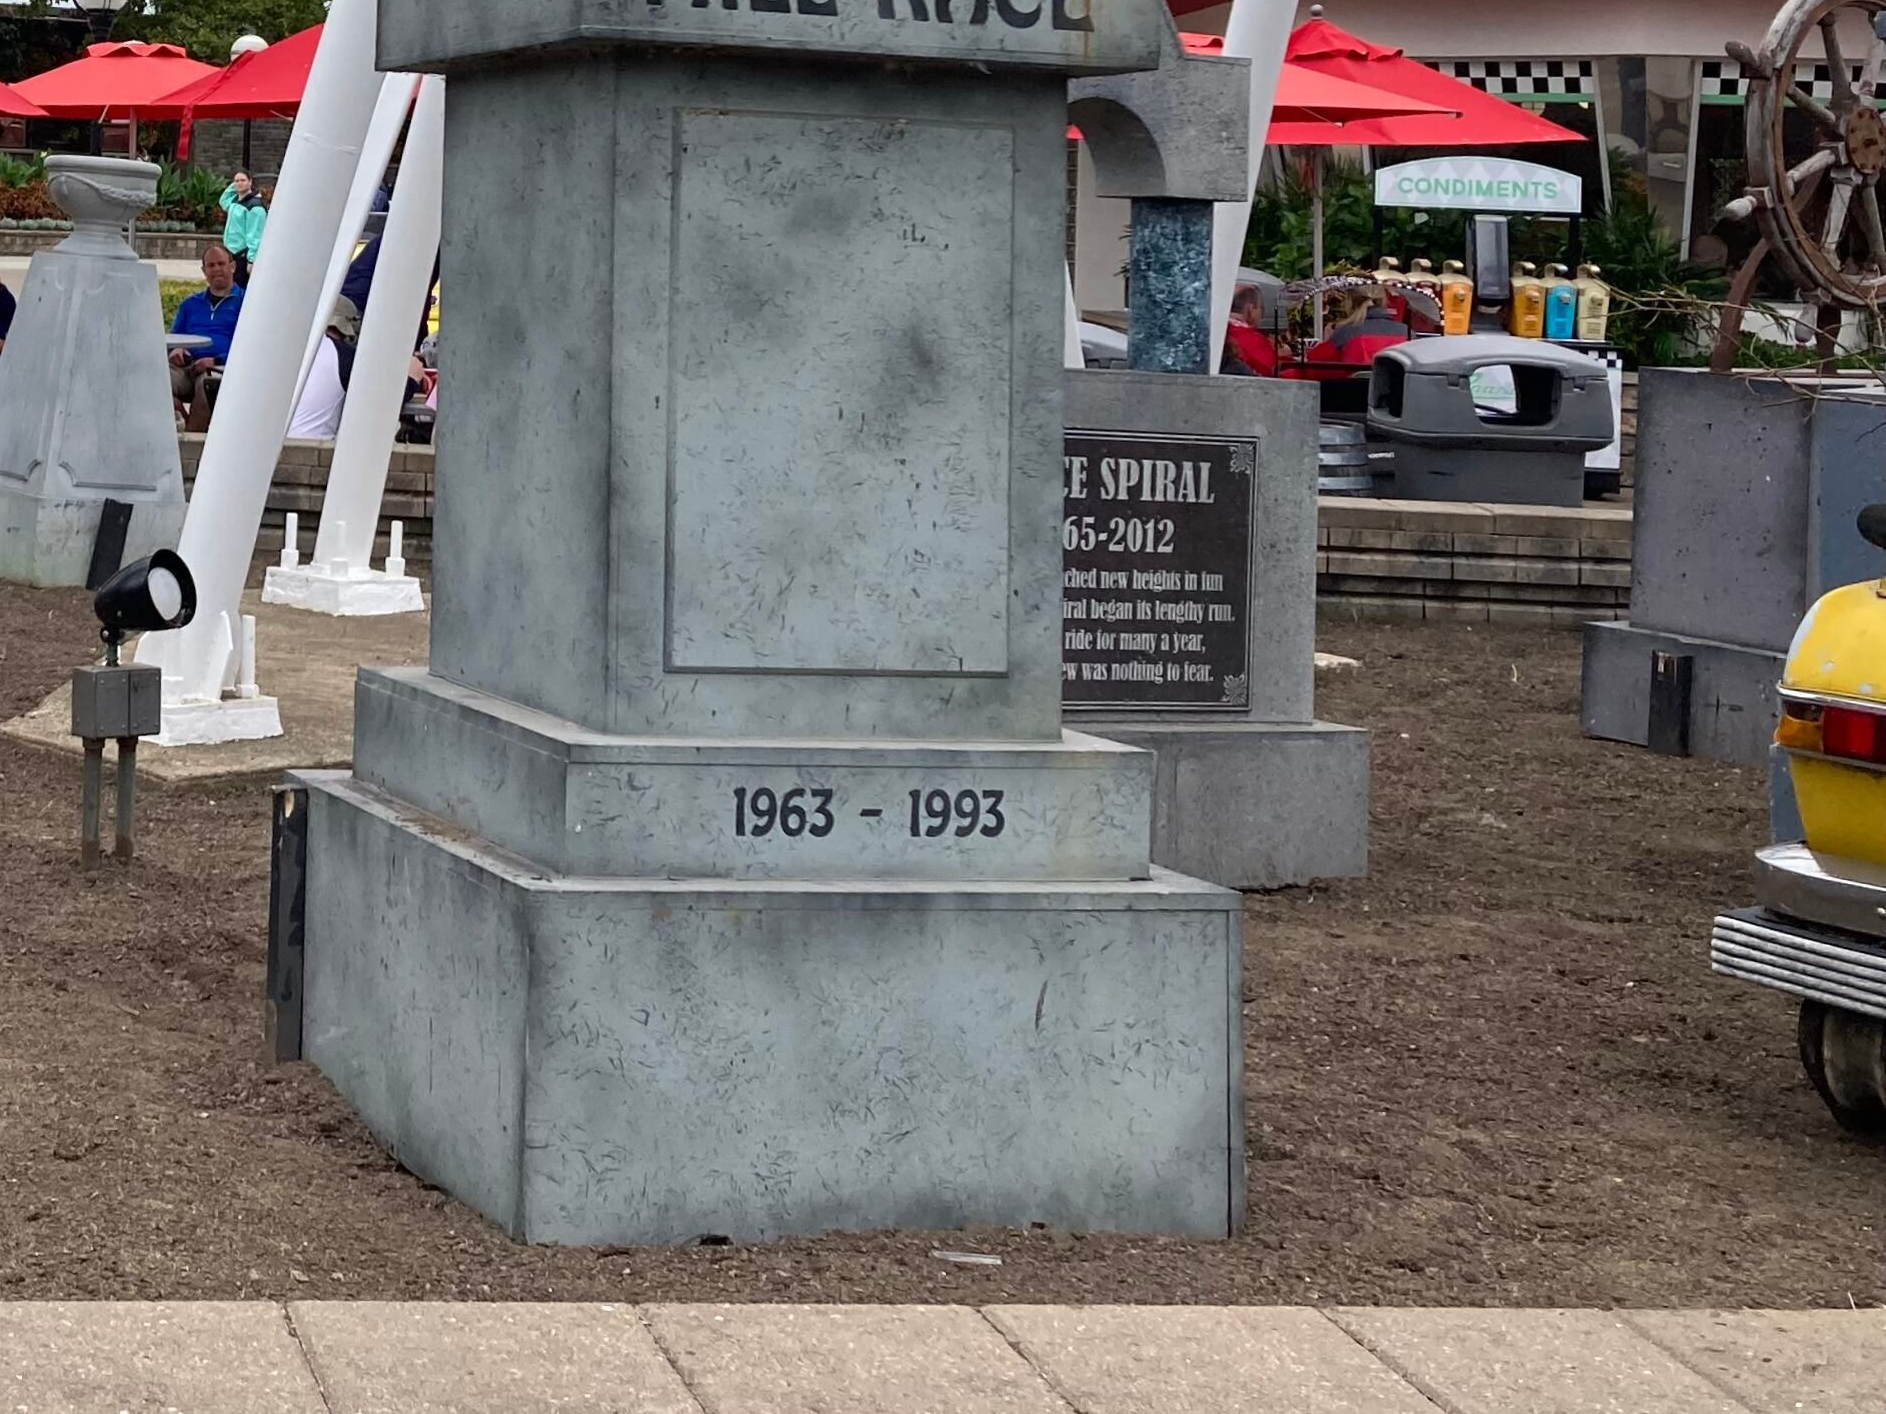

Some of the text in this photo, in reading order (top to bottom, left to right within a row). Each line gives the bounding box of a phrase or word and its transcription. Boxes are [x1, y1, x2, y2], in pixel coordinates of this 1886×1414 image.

[1397, 176, 1559, 199] CONDIMENTS
[1100, 457, 1215, 503] SPIRAL
[1064, 515, 1175, 554] 65-2012
[1065, 567, 1224, 593] ched new heights in fun
[1063, 598, 1236, 624] iral began its lengthy run.
[1065, 628, 1206, 654] ride for many a year,
[1062, 661, 1214, 684] ew was nothing to fear.
[733, 786, 835, 838] 1963
[908, 788, 1006, 838] 1993
